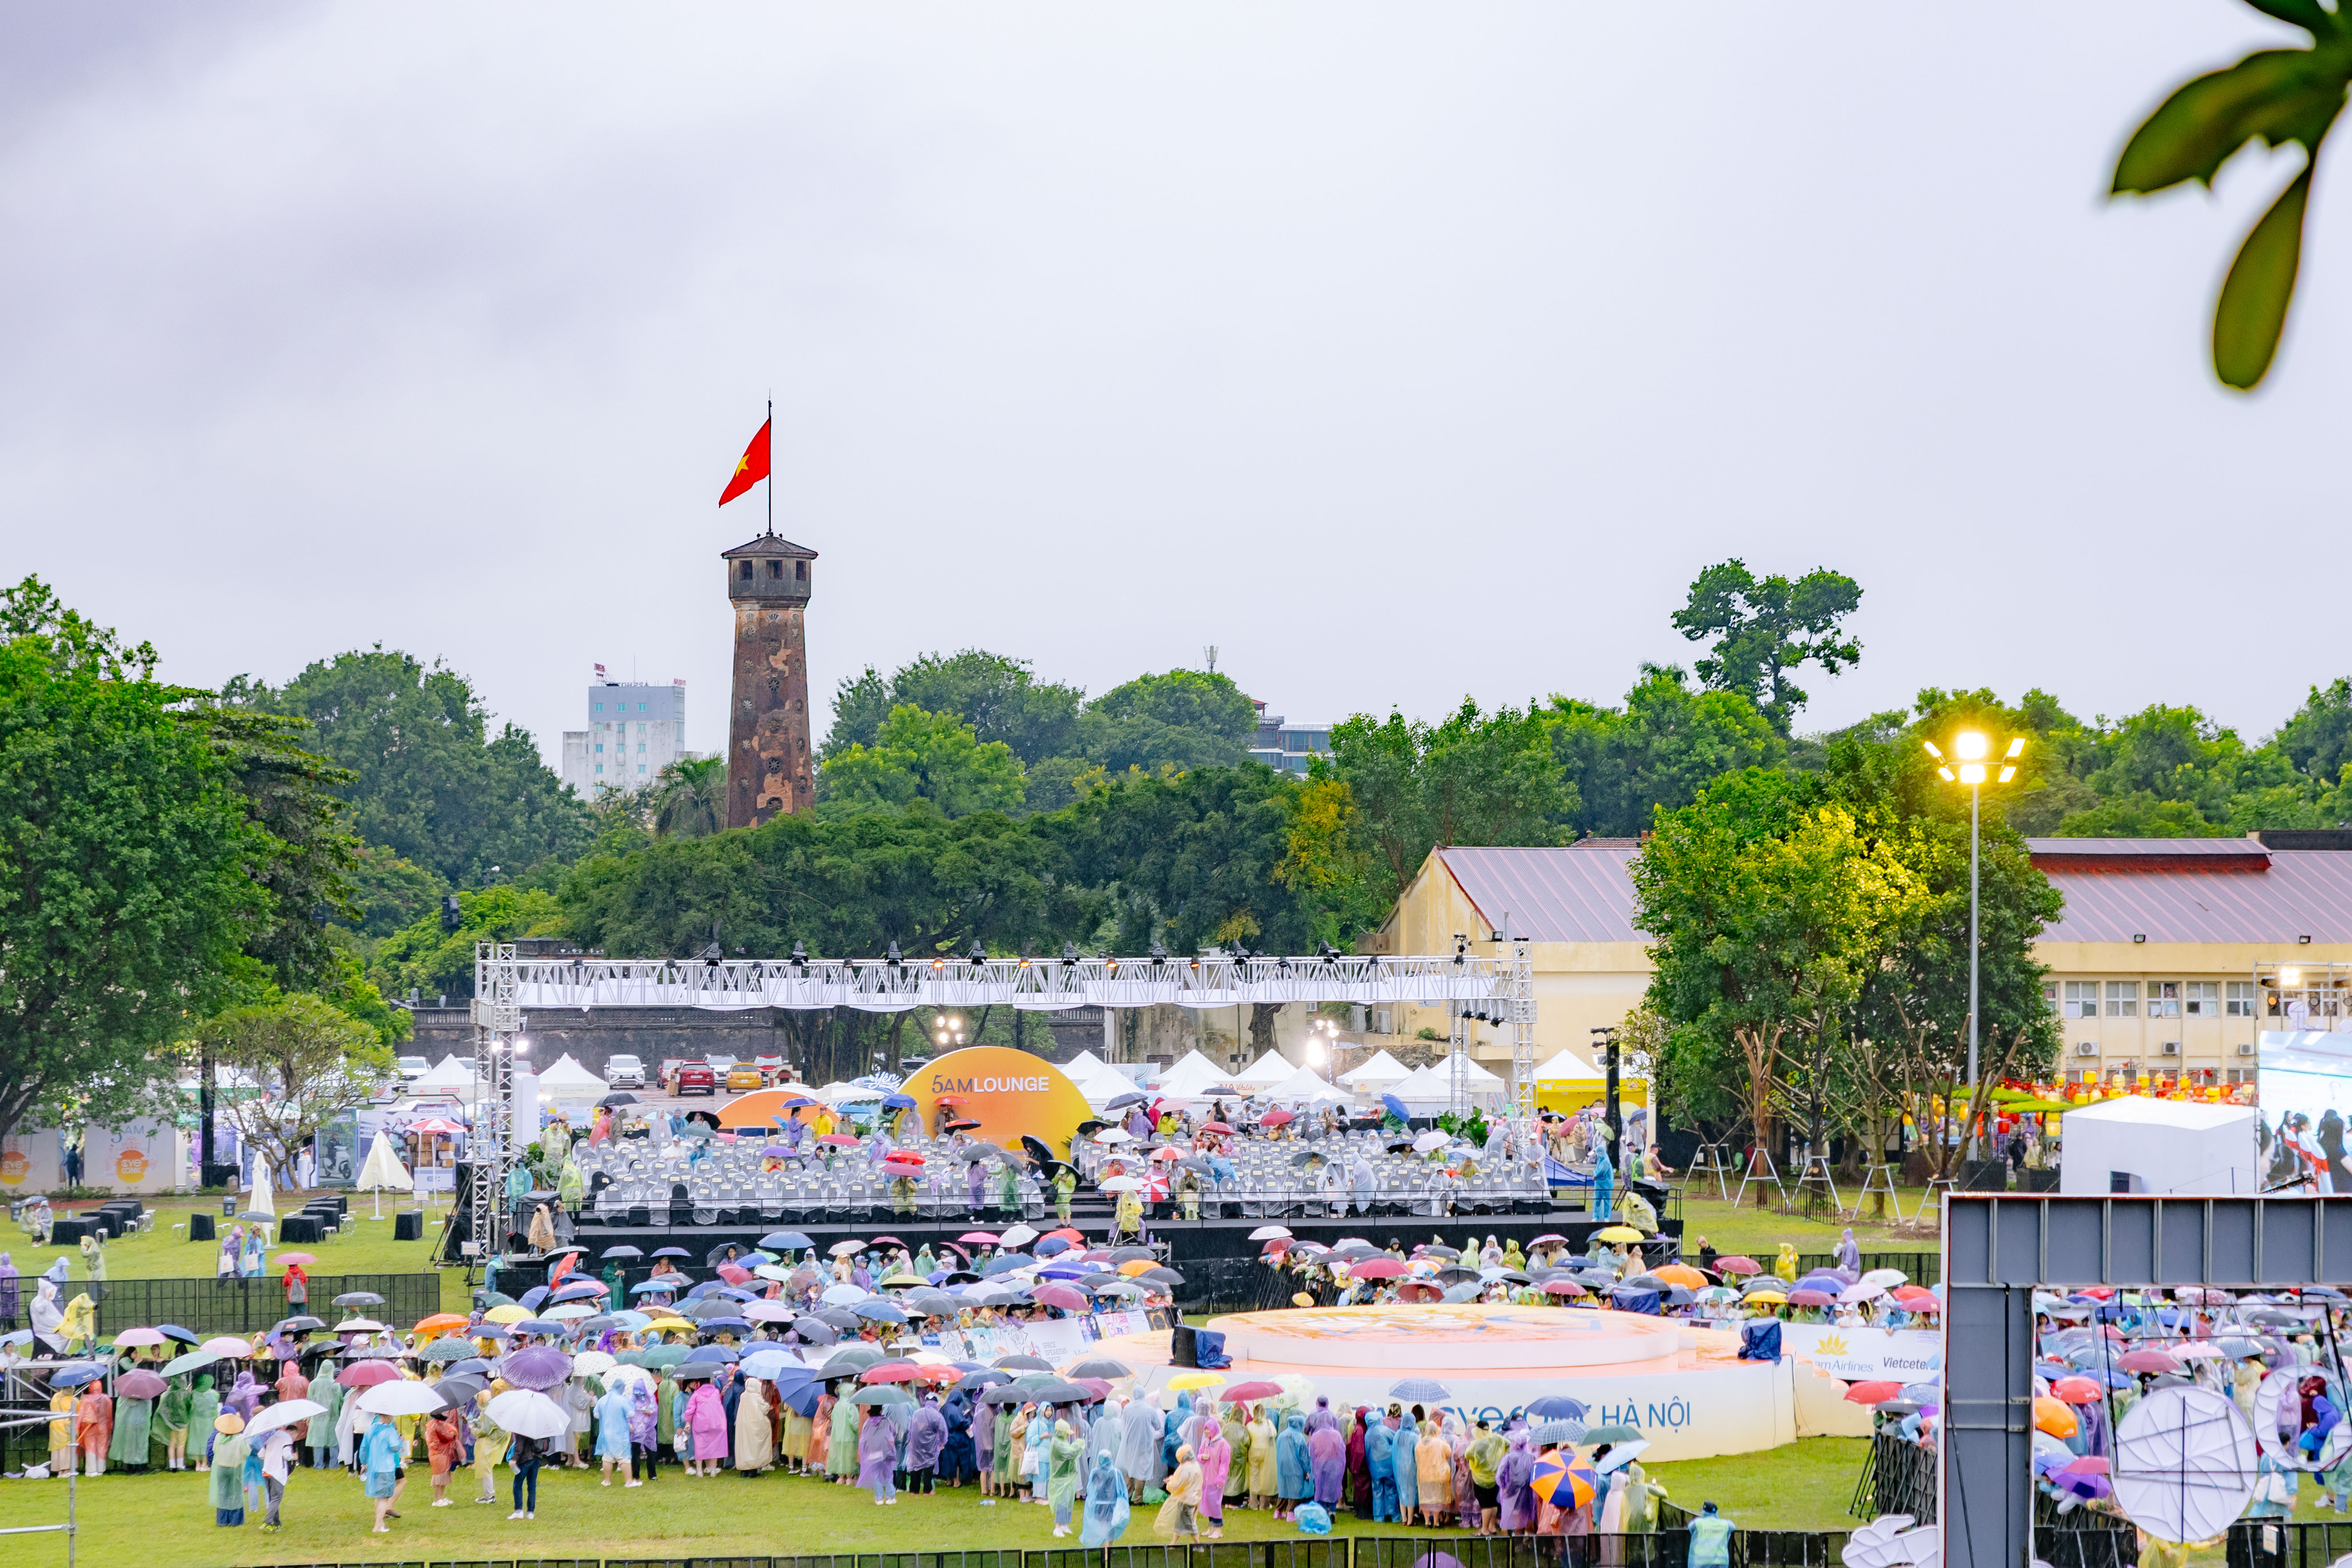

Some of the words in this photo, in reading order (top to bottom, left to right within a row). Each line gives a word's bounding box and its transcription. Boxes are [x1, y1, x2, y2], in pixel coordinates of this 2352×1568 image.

[1237, 1082, 1255, 1093] Vitality
[1832, 1360, 1874, 1372] Airlines
[1883, 1357, 1939, 1371] Vietcete
[1602, 1397, 1641, 1429] HÀ
[1649, 1396, 1690, 1433] NỘI
